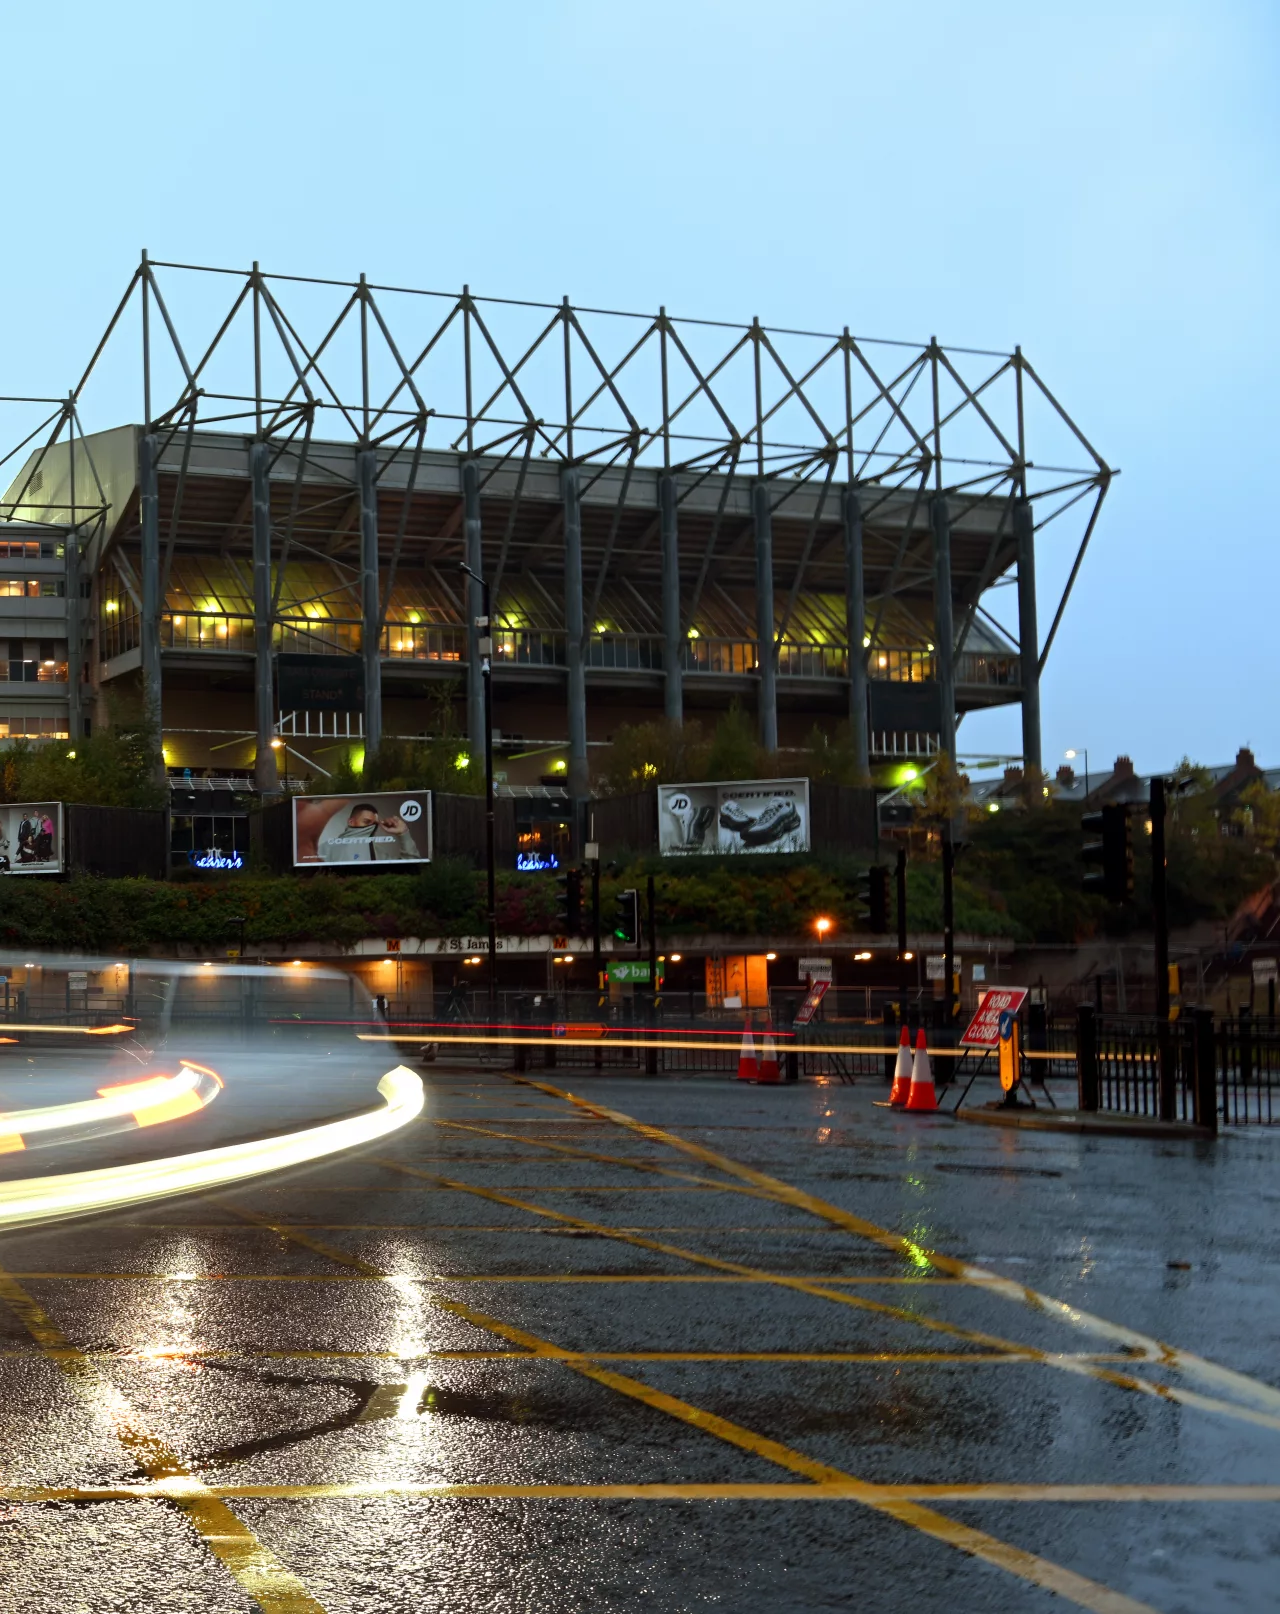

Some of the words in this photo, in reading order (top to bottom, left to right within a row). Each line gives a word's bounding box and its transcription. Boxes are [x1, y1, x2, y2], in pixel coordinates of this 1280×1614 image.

[672, 799, 688, 810] JD
[402, 805, 419, 817] JD
[388, 942, 400, 950] M
[450, 940, 462, 950] St
[467, 939, 503, 950] Jams
[554, 938, 566, 948] M
[987, 994, 1012, 1009] ROAD
[978, 1009, 1000, 1024] AHEA
[968, 1023, 999, 1040] CLOSED
